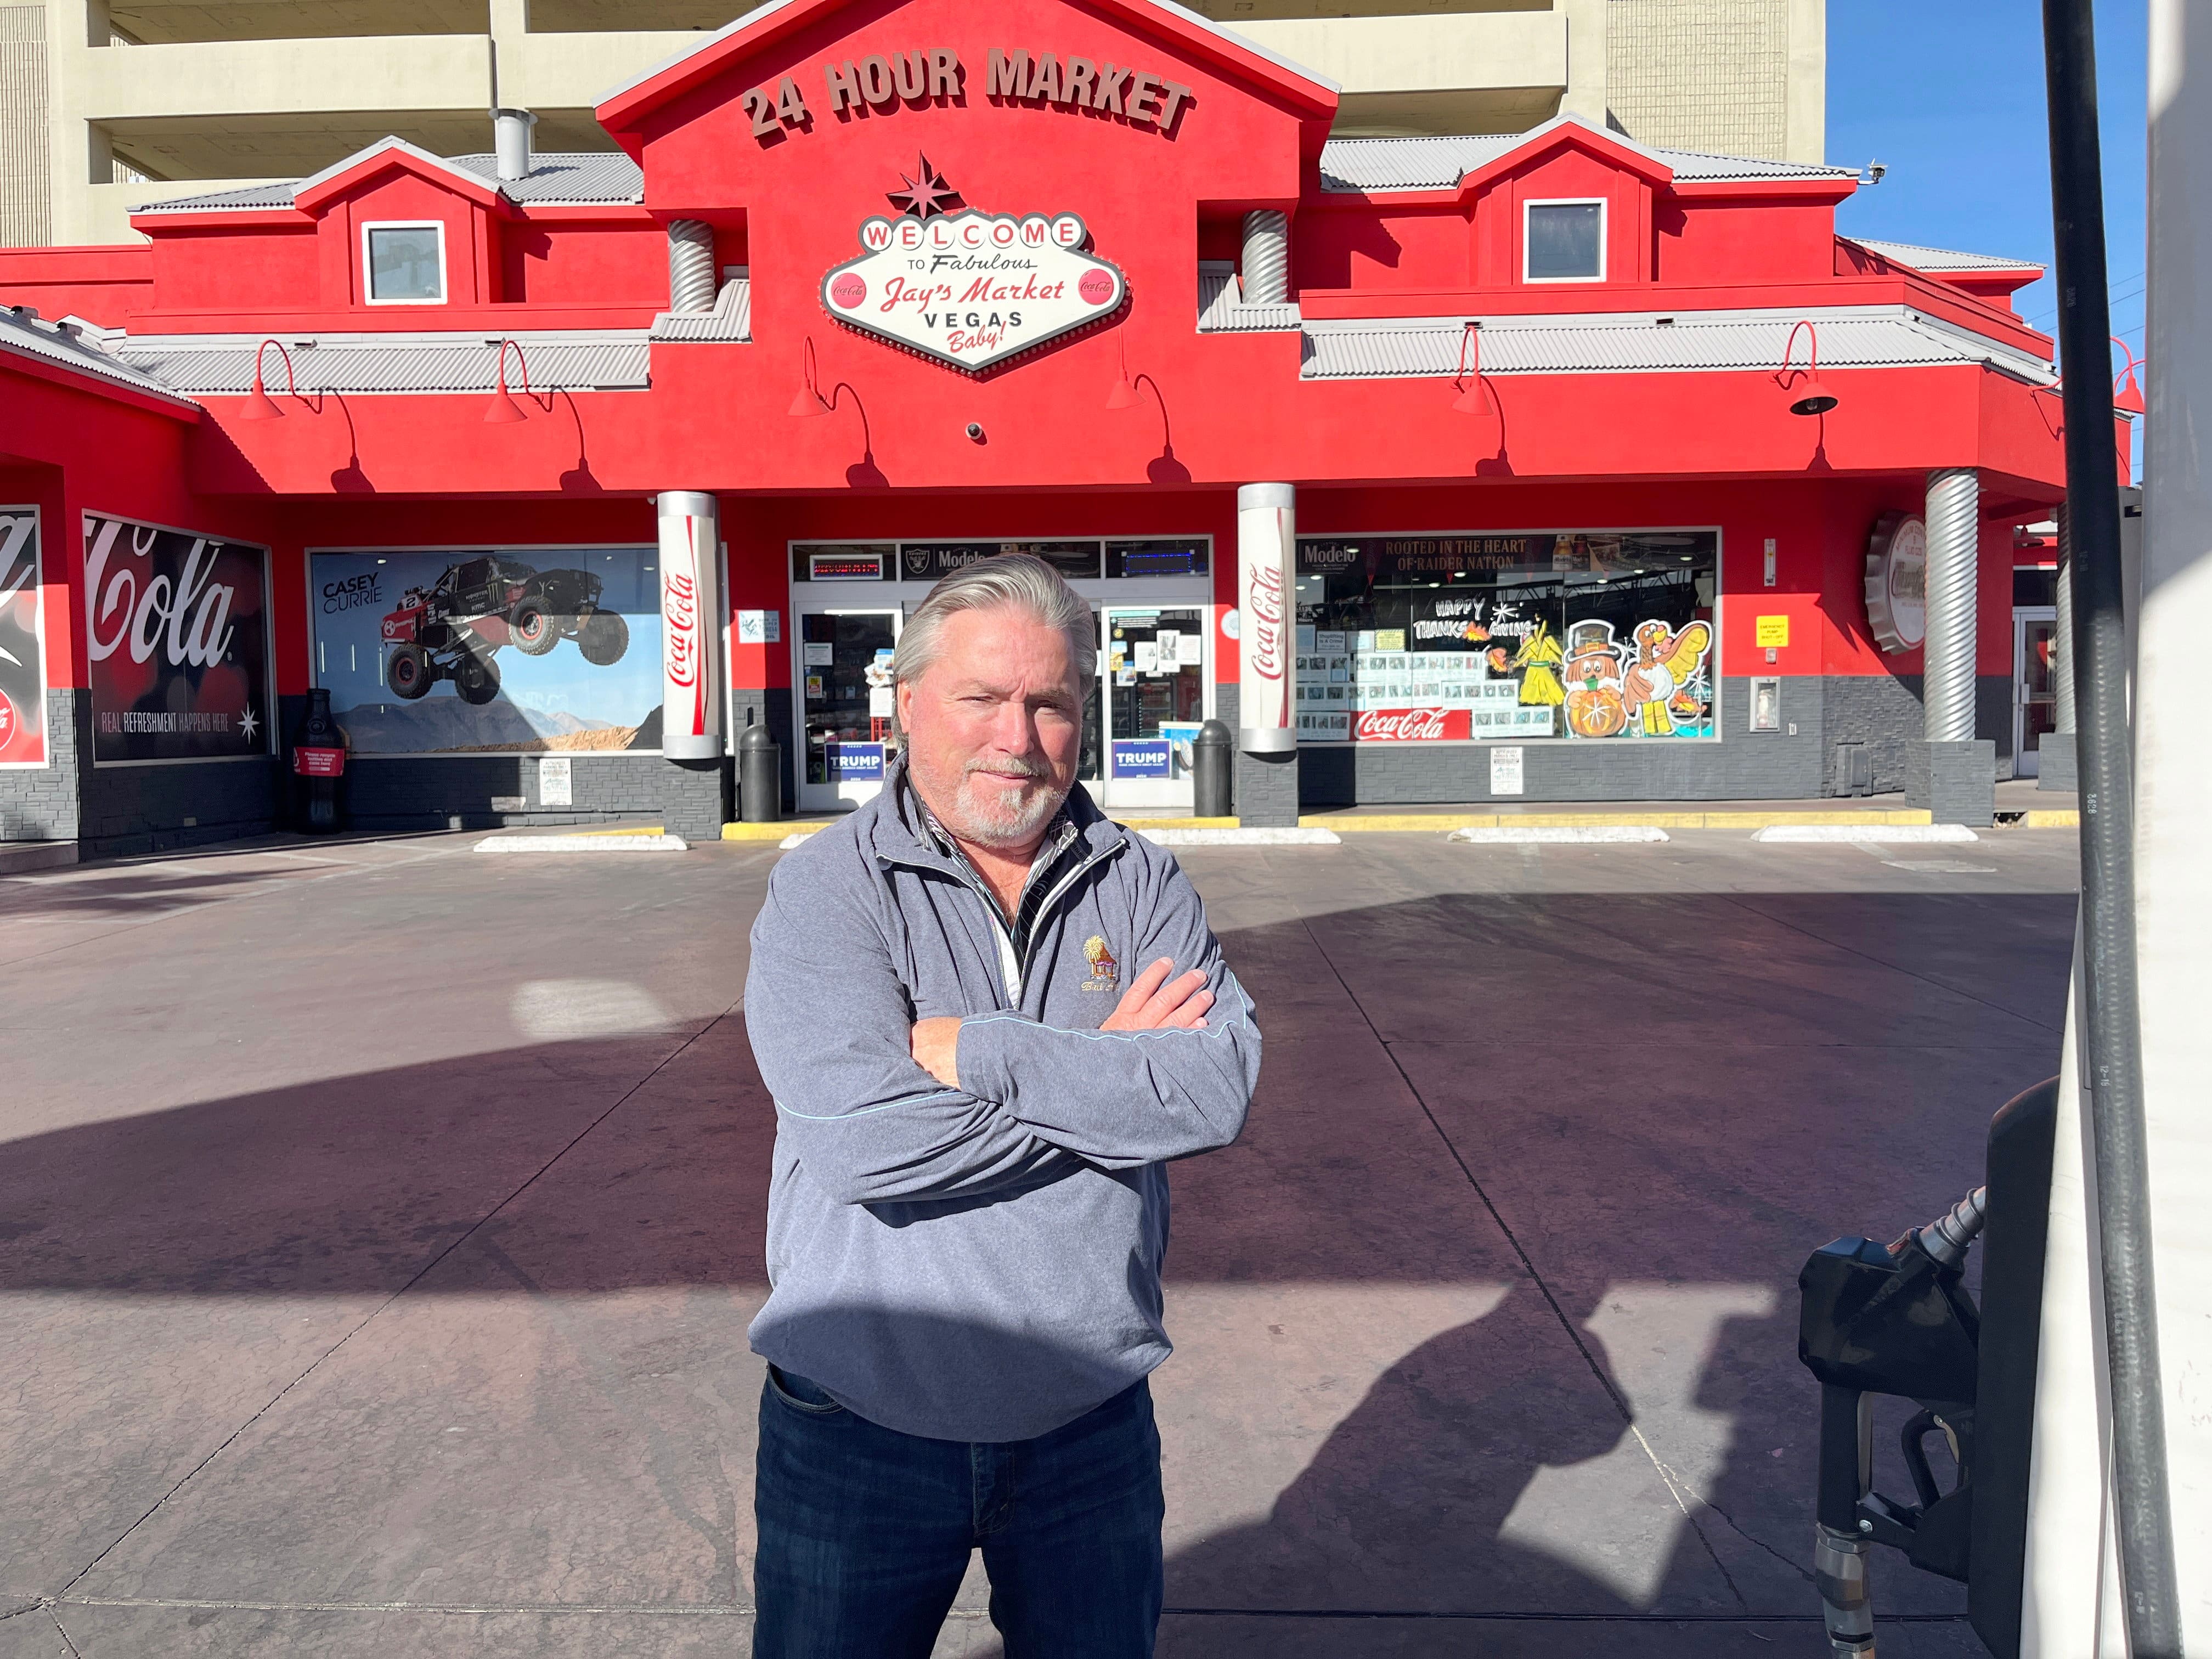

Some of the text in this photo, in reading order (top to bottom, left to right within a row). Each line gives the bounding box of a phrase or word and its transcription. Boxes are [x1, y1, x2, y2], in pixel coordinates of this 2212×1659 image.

[741, 48, 1192, 138] 24 HOUR MARKET
[867, 222, 1074, 246] WELCOME
[907, 254, 1038, 274] TO Fabulous
[879, 273, 1064, 314] Jay's Market
[924, 311, 1023, 328] VEGAS
[947, 320, 1007, 353] Baby!
[1305, 545, 1356, 563] Modelo
[1386, 539, 1527, 555] ROOTED IN THE HEART
[1397, 556, 1514, 571] OF RAIDER NATION
[323, 571, 379, 599] CASEY
[323, 586, 383, 614] CURRIE
[1435, 597, 1486, 621] HAPPY
[101, 712, 229, 733] REAL REFRESHMENT HAPPENS HERE
[830, 755, 881, 767] TRUMP
[1116, 752, 1167, 764] TRUMP
